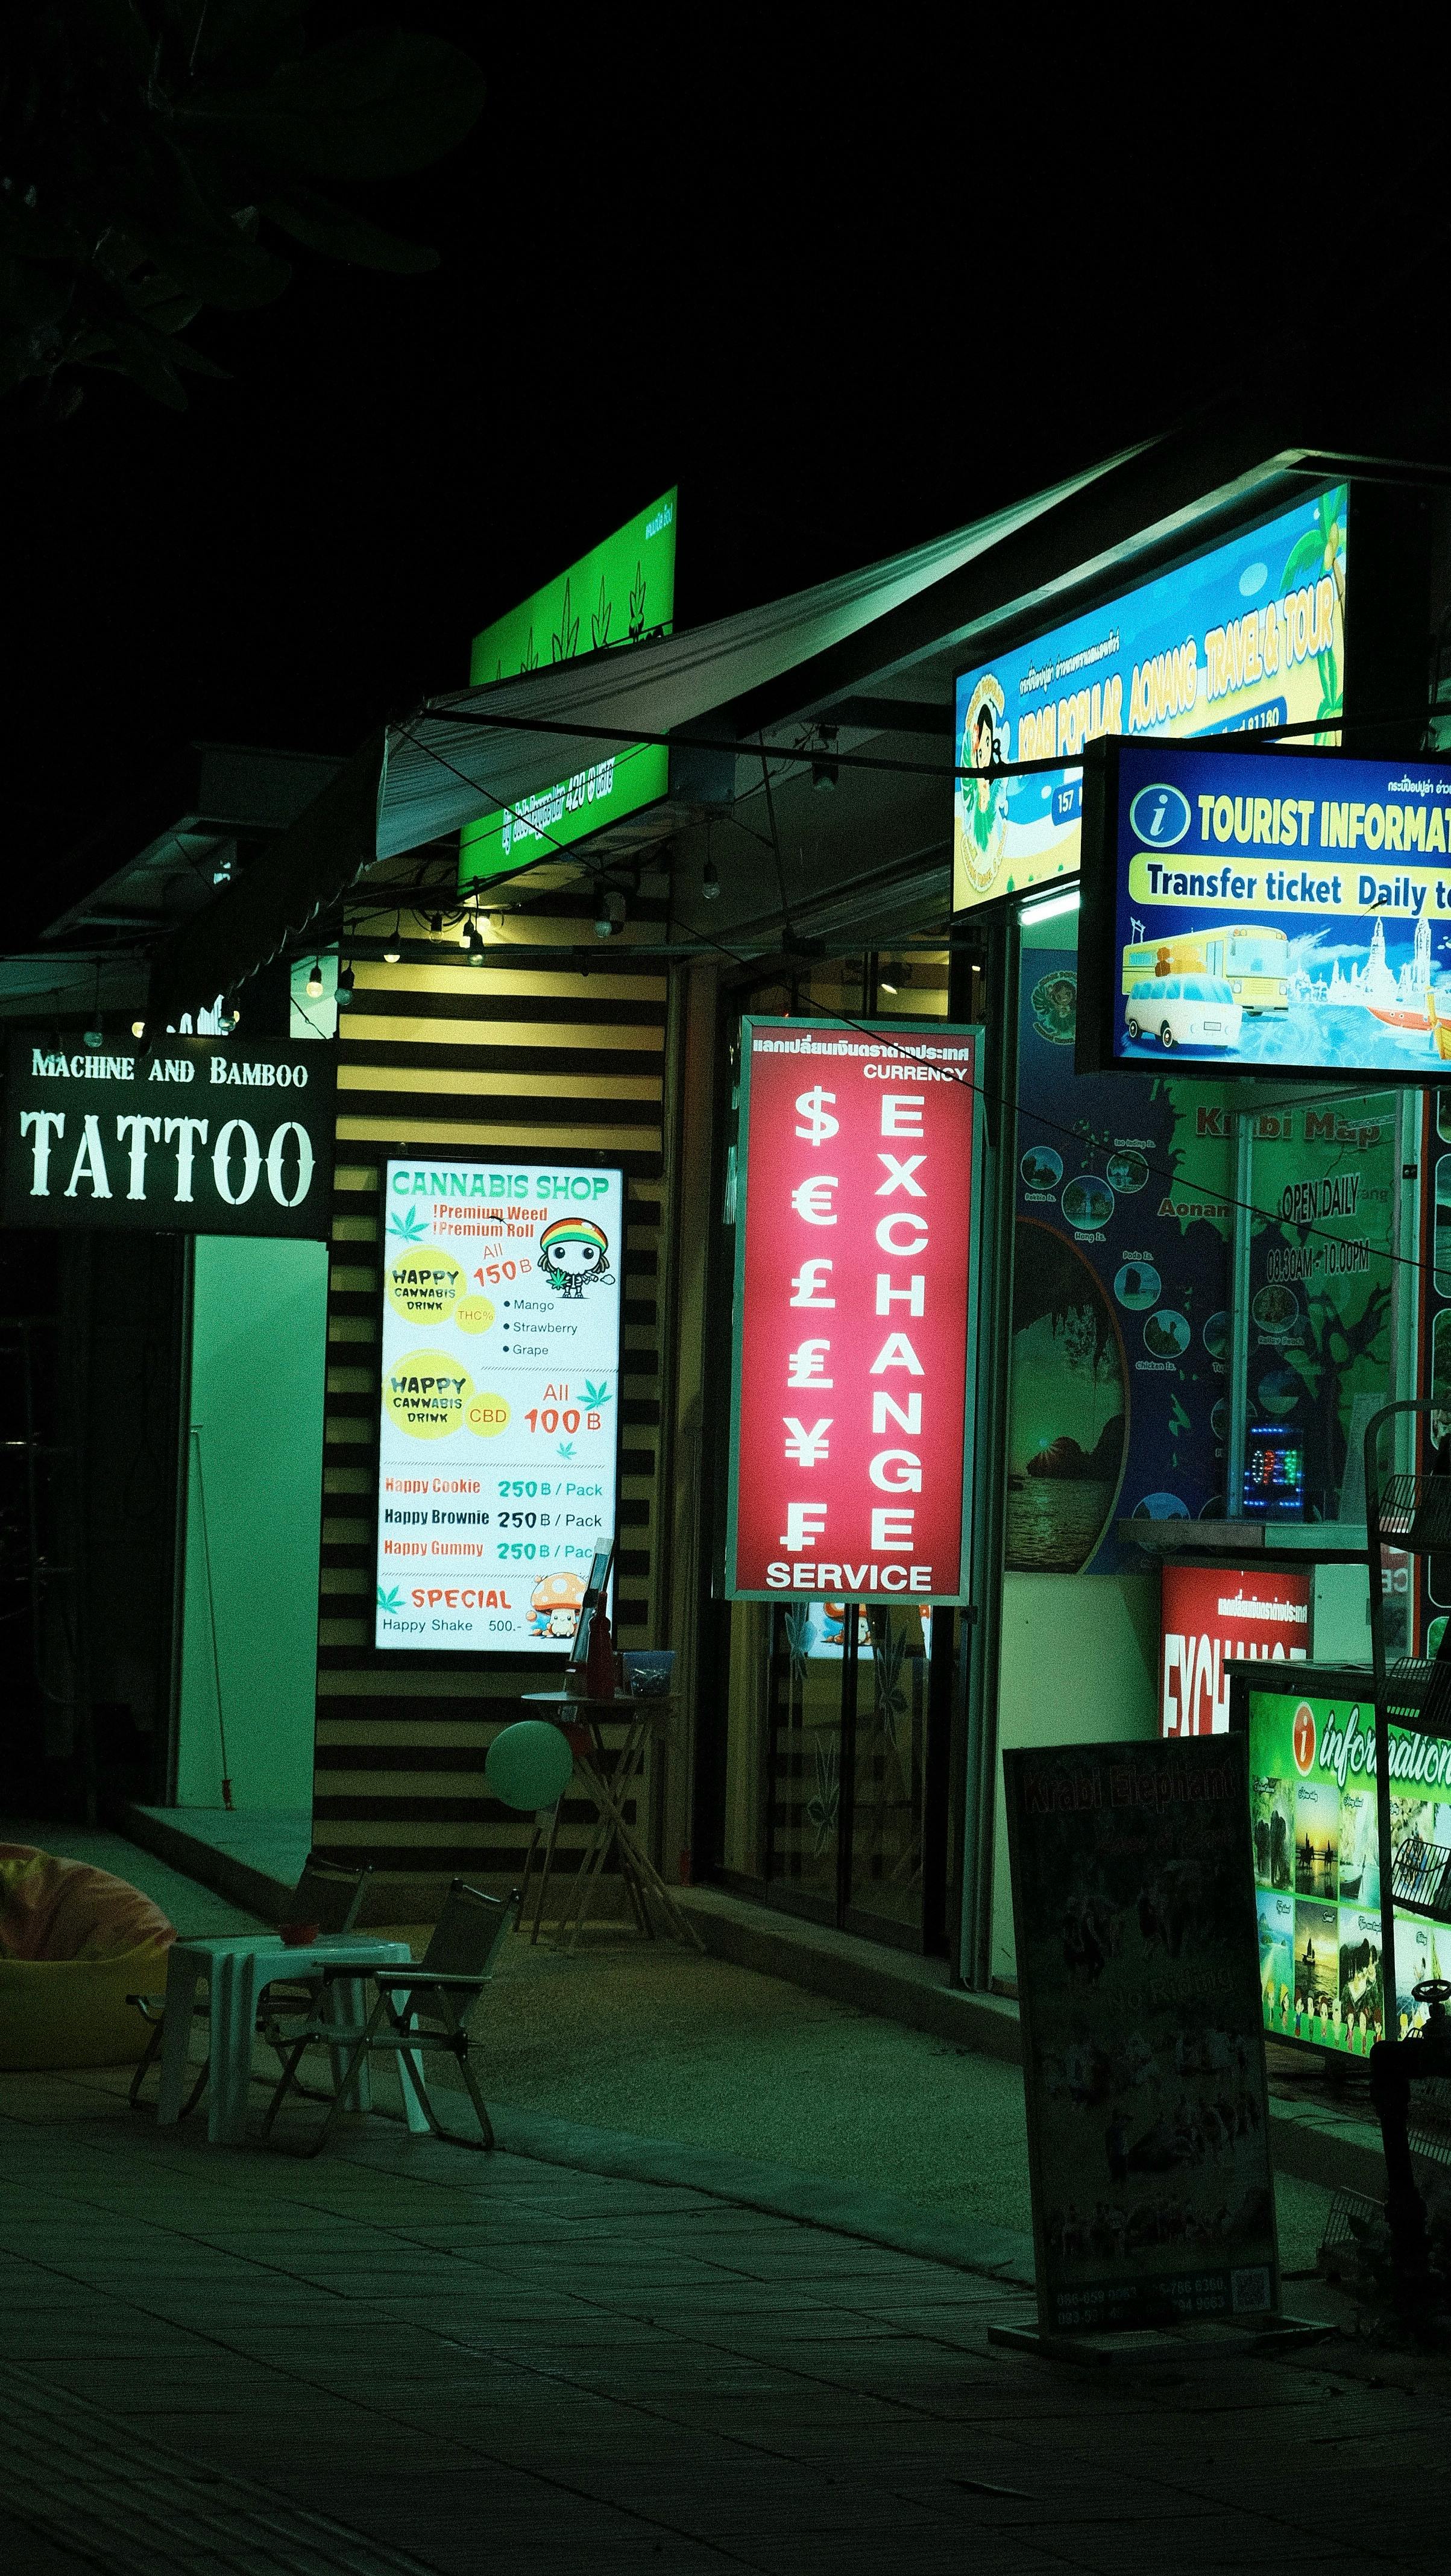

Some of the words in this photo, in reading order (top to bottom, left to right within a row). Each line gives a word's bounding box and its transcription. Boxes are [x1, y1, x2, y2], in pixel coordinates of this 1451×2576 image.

[1018, 701, 1056, 763] KRABI
[1057, 673, 1123, 757] POPULAR
[1128, 637, 1198, 734] AONANG
[1204, 608, 1264, 701] TRAVEL
[1284, 575, 1334, 668] TOUR
[1058, 789, 1074, 813] 157
[1198, 794, 1315, 847] TOURIST
[1147, 863, 1257, 899] Transfer
[1266, 871, 1341, 904] ticket
[1359, 875, 1427, 916] Daily
[148, 1059, 195, 1083] AND
[210, 1057, 309, 1088] BAMBOO
[863, 1063, 968, 1082] CURRENCY
[795, 1085, 840, 1146] $
[20, 1110, 316, 1208] TATTOO
[392, 1170, 529, 1199] CANNABIS
[536, 1175, 609, 1201] SHOP
[791, 1175, 839, 1225] €
[1157, 1197, 1232, 1218] Aonan
[508, 1206, 548, 1221] Weed
[506, 1223, 534, 1238] Roll
[483, 1243, 503, 1260] All
[1122, 1250, 1142, 1261] Poda
[392, 1269, 459, 1285] HAPPY
[473, 1260, 517, 1287] 150
[394, 1287, 456, 1299] CANNABIS
[407, 1301, 443, 1311] DRINK
[458, 1310, 494, 1321] THC%
[514, 1300, 555, 1312] Mango
[513, 1322, 578, 1336] Strawberry
[869, 1094, 929, 1551] EXCHANGE
[512, 1344, 549, 1356] Grape
[1135, 1361, 1164, 1371] Chicken
[390, 1376, 466, 1394] HAPPY
[543, 1384, 569, 1401] All
[393, 1397, 462, 1409] CANNABIS
[408, 1412, 449, 1423] DRINK
[470, 1409, 507, 1423] CBD
[524, 1408, 581, 1434] 100
[385, 1477, 429, 1493] Happy
[432, 1478, 481, 1494] Cookie
[498, 1480, 538, 1497] 250
[566, 1482, 603, 1497] Pack
[385, 1508, 428, 1525] Happy
[432, 1510, 490, 1525] Brownie
[498, 1511, 537, 1528] 250
[565, 1513, 603, 1527] Pack
[384, 1540, 427, 1556] Happy
[431, 1540, 484, 1557] Gummy
[497, 1543, 536, 1560] 250
[564, 1545, 594, 1559] Pac
[766, 1561, 933, 1592] SERVICE
[411, 1589, 512, 1610] SPECIAL
[383, 1619, 426, 1633] Happy
[432, 1619, 473, 1632] Shake
